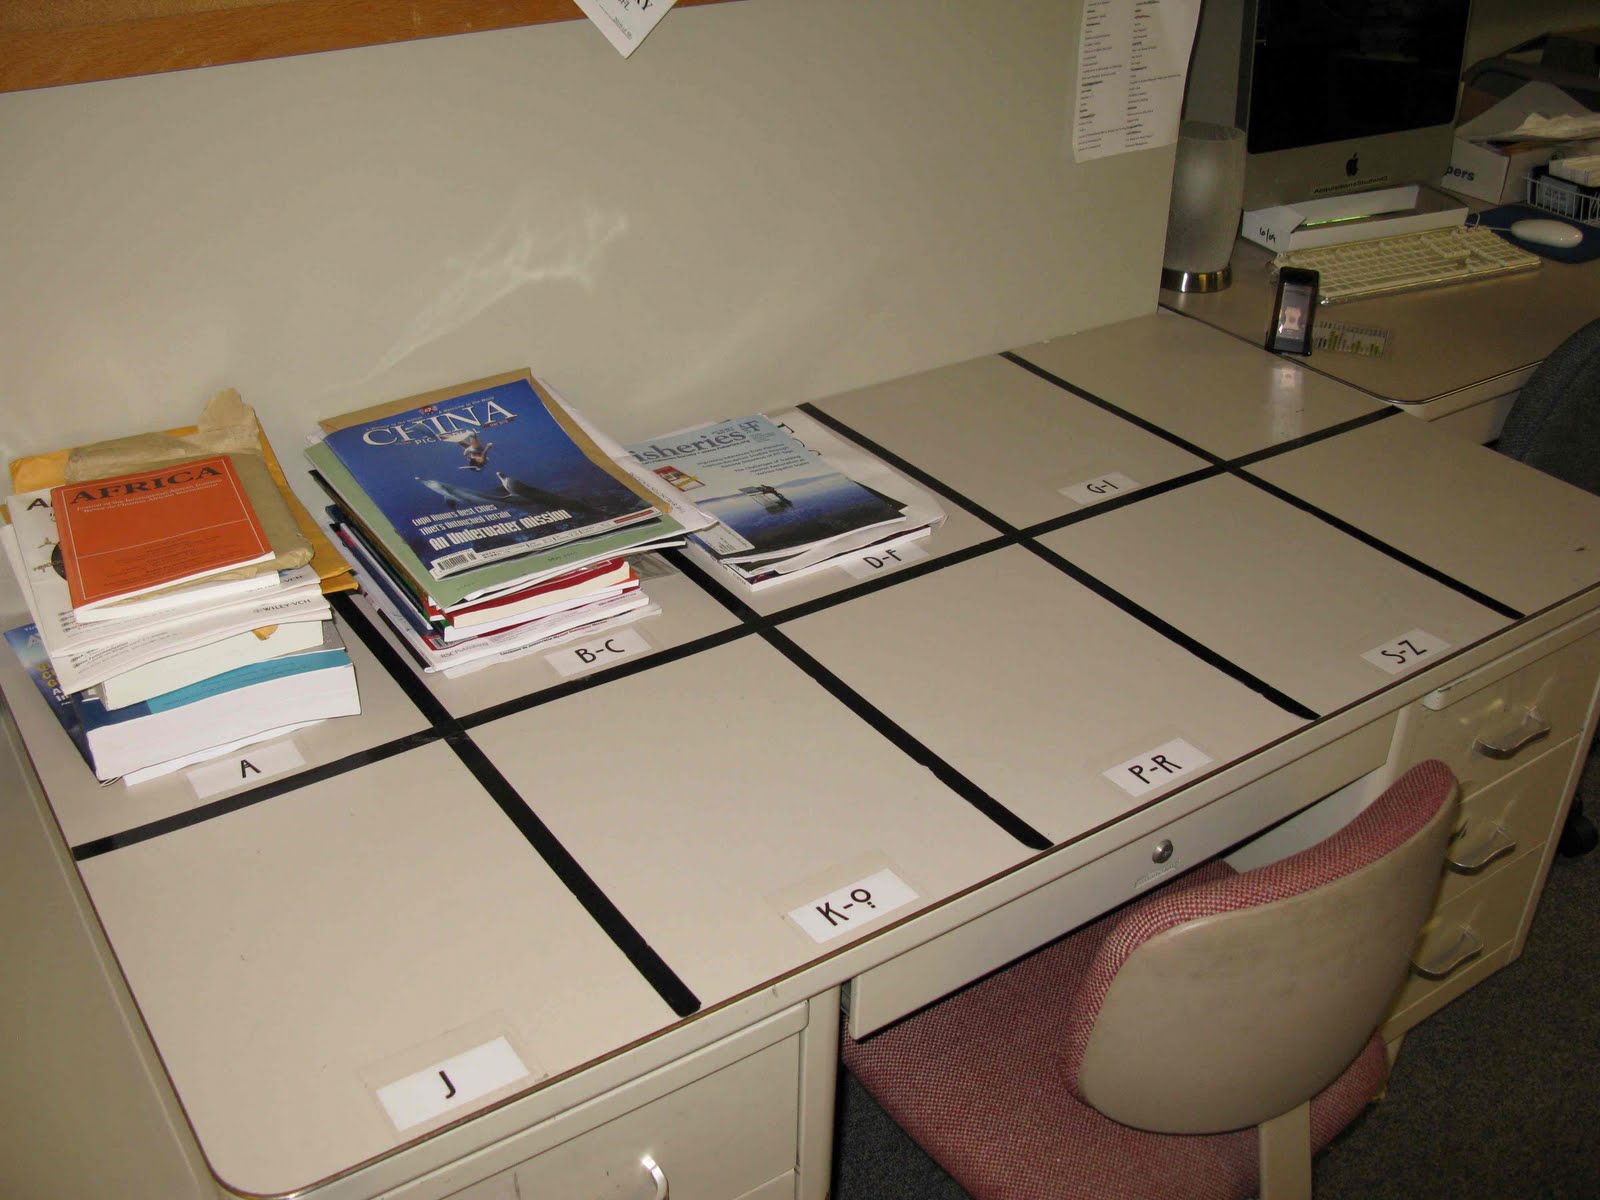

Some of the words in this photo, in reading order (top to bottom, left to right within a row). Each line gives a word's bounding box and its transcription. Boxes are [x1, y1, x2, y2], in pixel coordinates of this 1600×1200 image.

[1446, 165, 1475, 181] pers
[362, 400, 518, 446] CHINA
[628, 430, 747, 462] isheries
[70, 466, 223, 504] AFRICA
[1086, 478, 1120, 495] G-I
[448, 520, 522, 545] Underwater
[862, 549, 902, 569] D-F
[574, 638, 626, 664] B-C
[1380, 638, 1428, 665] S-Z
[240, 759, 262, 779] A
[1127, 753, 1183, 785] P-R
[438, 1069, 458, 1100] J
